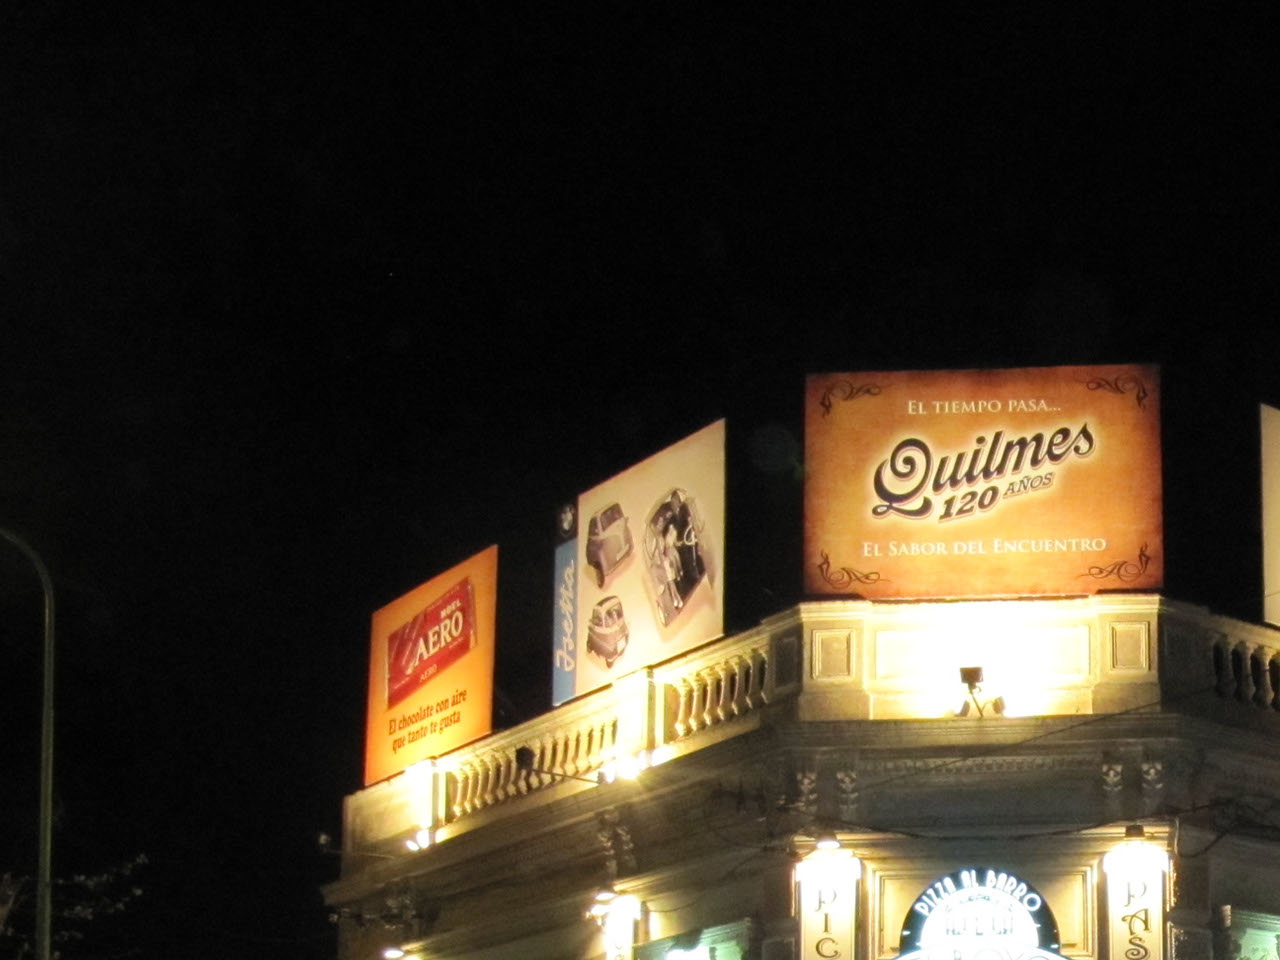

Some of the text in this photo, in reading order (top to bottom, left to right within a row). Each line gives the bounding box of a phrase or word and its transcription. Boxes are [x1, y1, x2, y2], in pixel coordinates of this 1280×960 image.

[935, 399, 1002, 414] TIEMPO
[871, 421, 1096, 519] Quilmes
[939, 472, 1054, 521] 120 AÑOS
[889, 541, 947, 556] SABOR
[953, 540, 986, 555] DEL
[993, 538, 1107, 554] ENCUENTRO
[405, 610, 464, 675] AERO
[388, 689, 467, 736] El chocolate con aire
[392, 711, 461, 755] que tanto te gusta
[914, 869, 1042, 916] PIZZA AL BARRO
